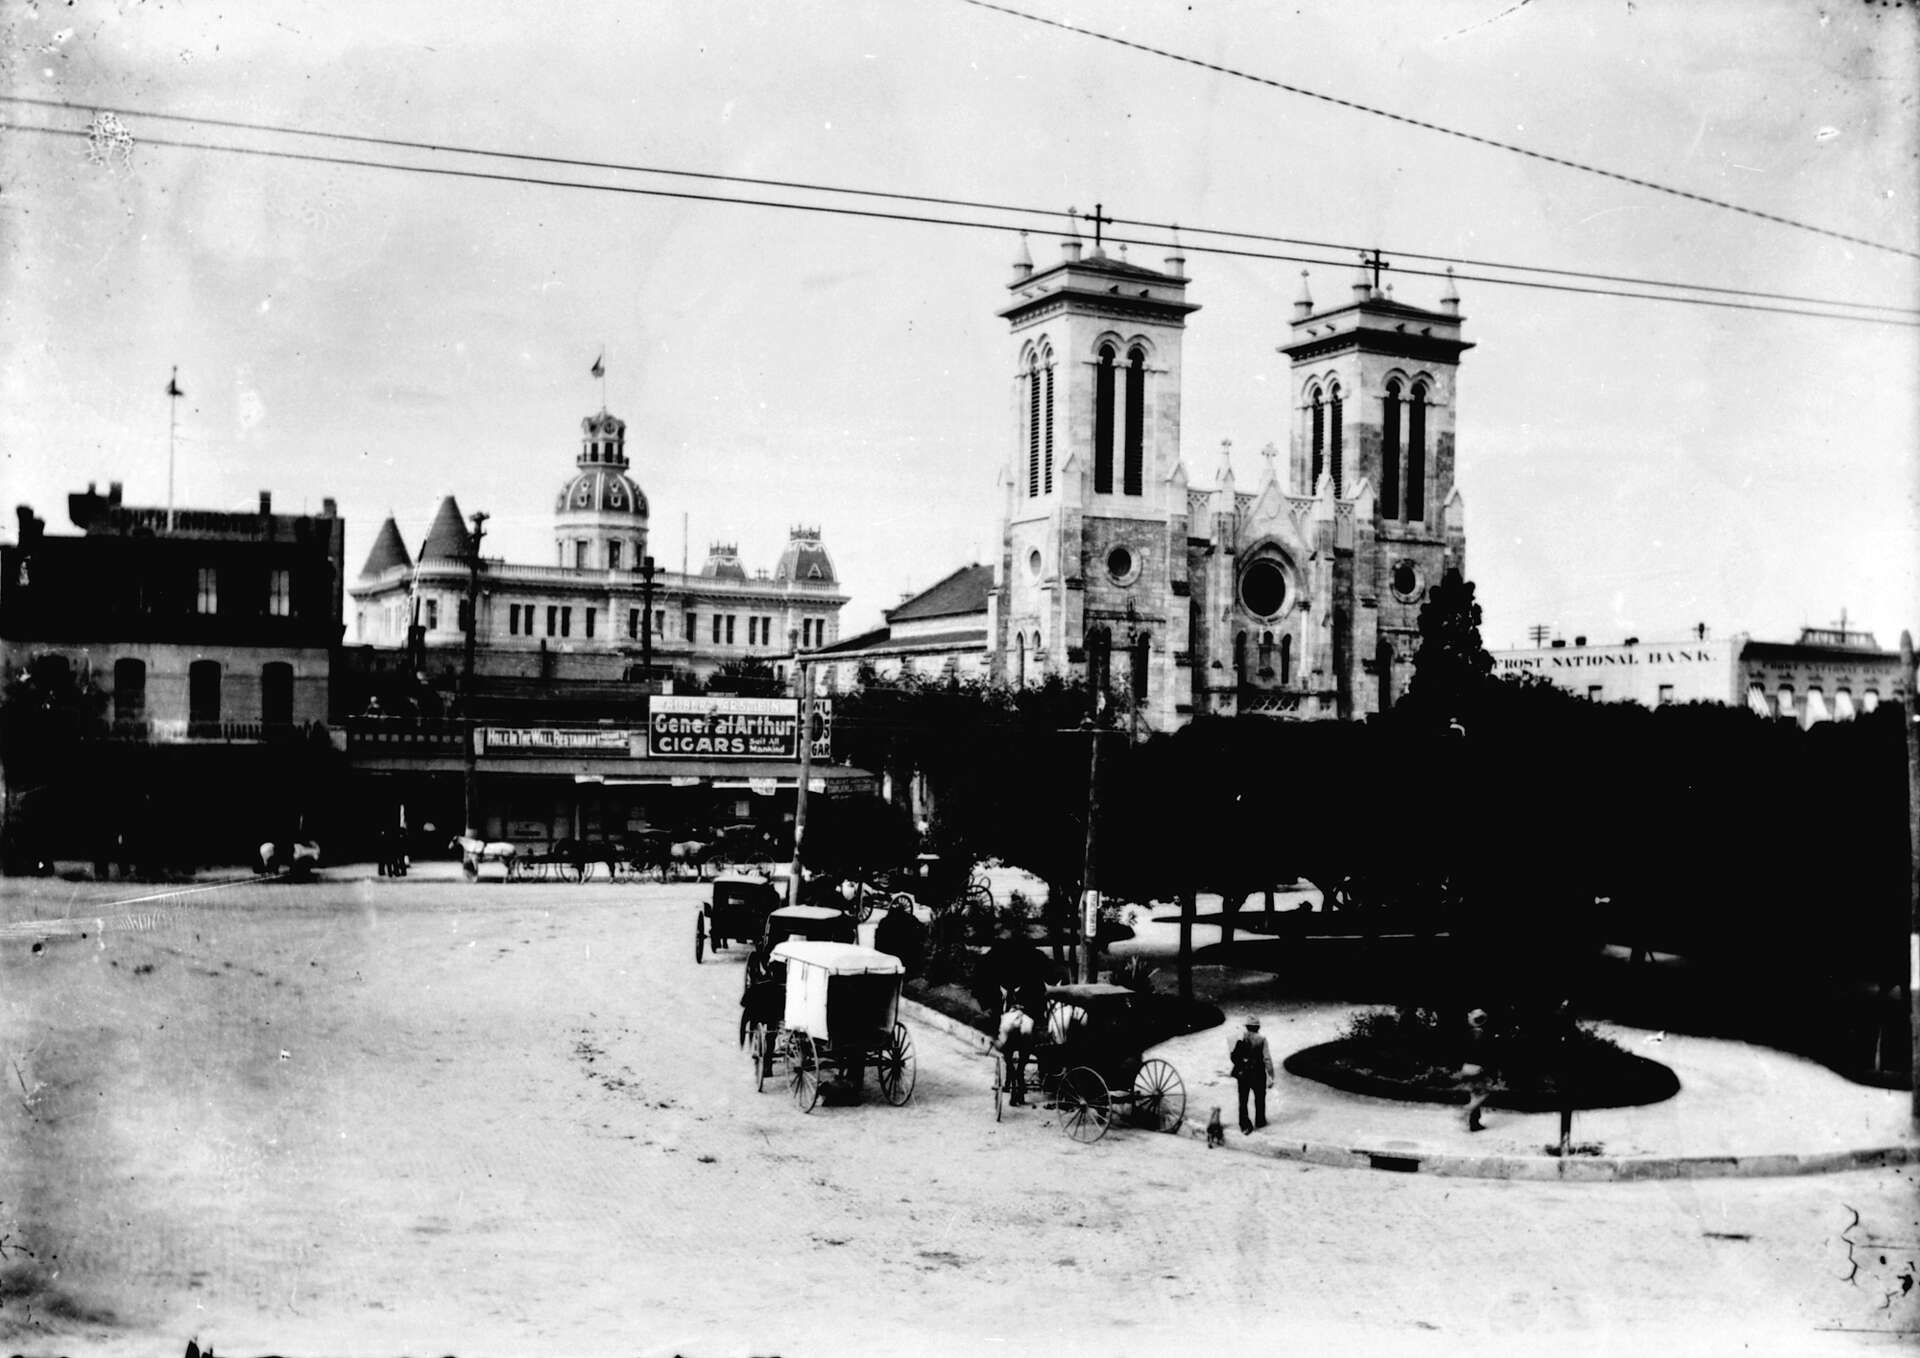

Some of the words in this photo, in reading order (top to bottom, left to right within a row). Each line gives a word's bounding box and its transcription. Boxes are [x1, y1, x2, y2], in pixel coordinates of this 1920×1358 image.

[1493, 657, 1544, 669] FROST
[1552, 653, 1639, 667] NATIONAL
[655, 713, 733, 735] General
[735, 715, 795, 736] Arthur
[531, 729, 553, 747] WALL
[554, 729, 600, 748] RESTAURANT
[658, 736, 745, 753] CIGARS
